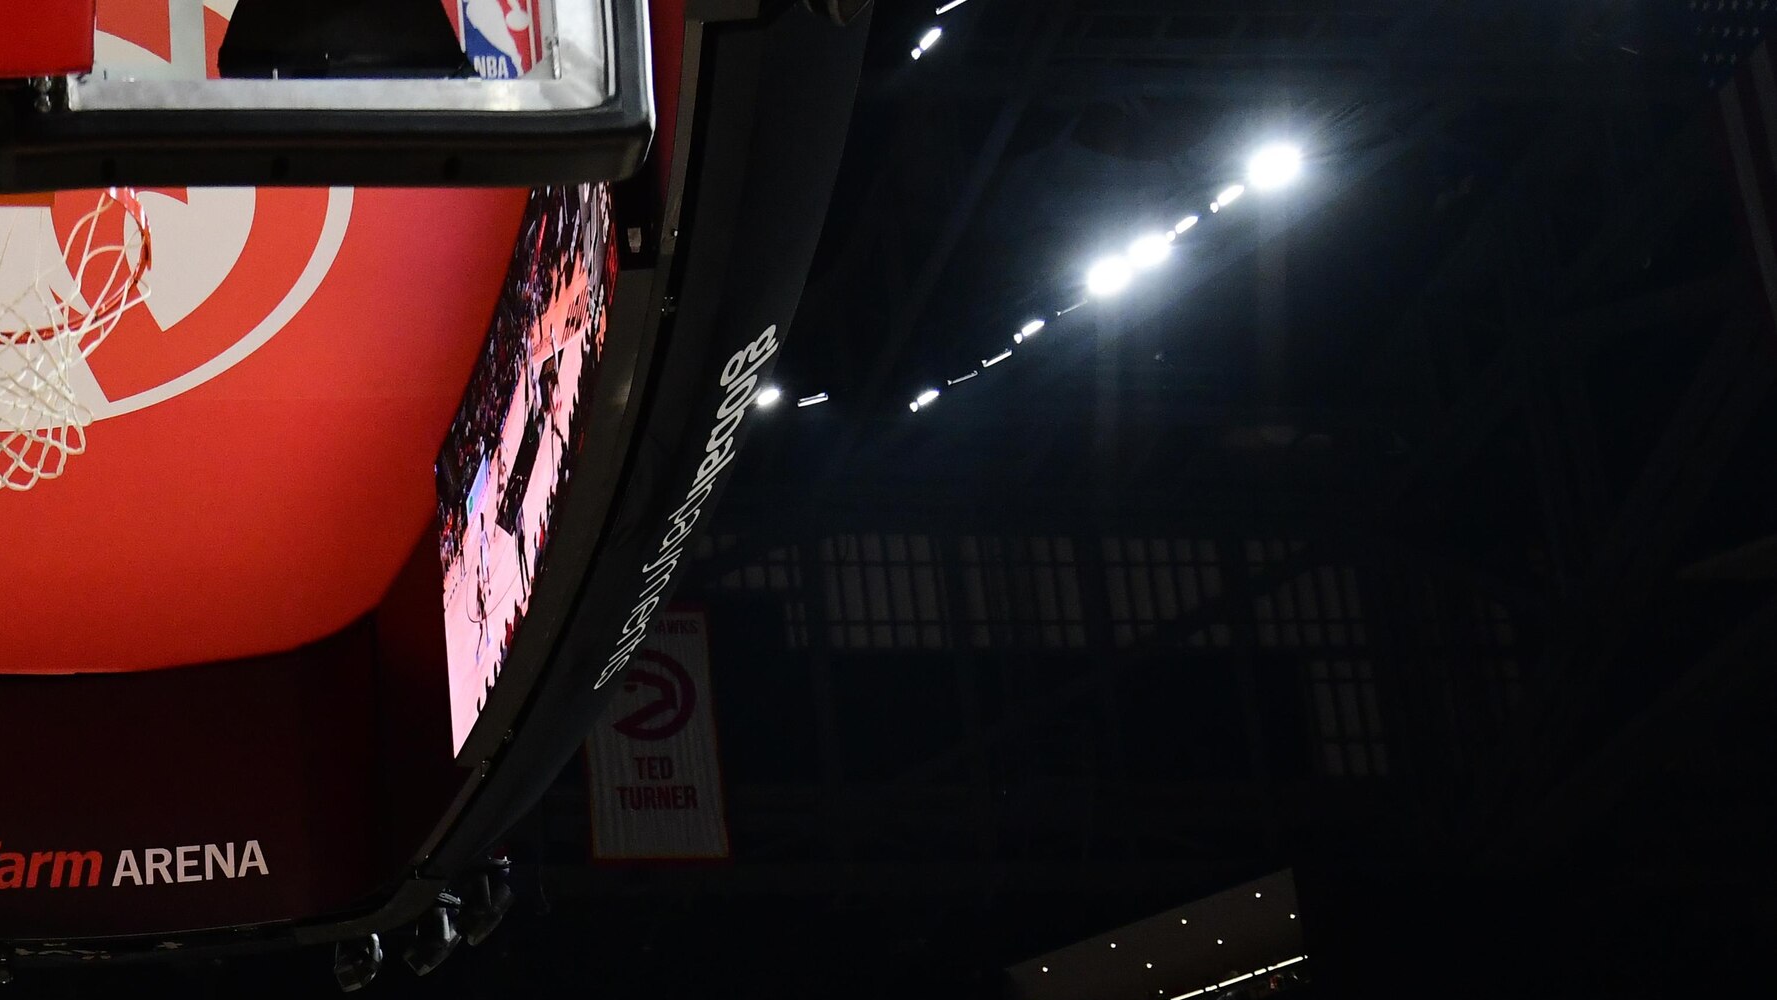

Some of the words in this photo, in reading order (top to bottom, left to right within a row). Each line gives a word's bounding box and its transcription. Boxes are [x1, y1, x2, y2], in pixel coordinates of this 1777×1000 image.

[474, 55, 509, 79] NBA
[655, 620, 698, 634] AWKS
[633, 756, 674, 780] TED
[616, 786, 698, 810] TURNER
[111, 839, 269, 887] ARENA
